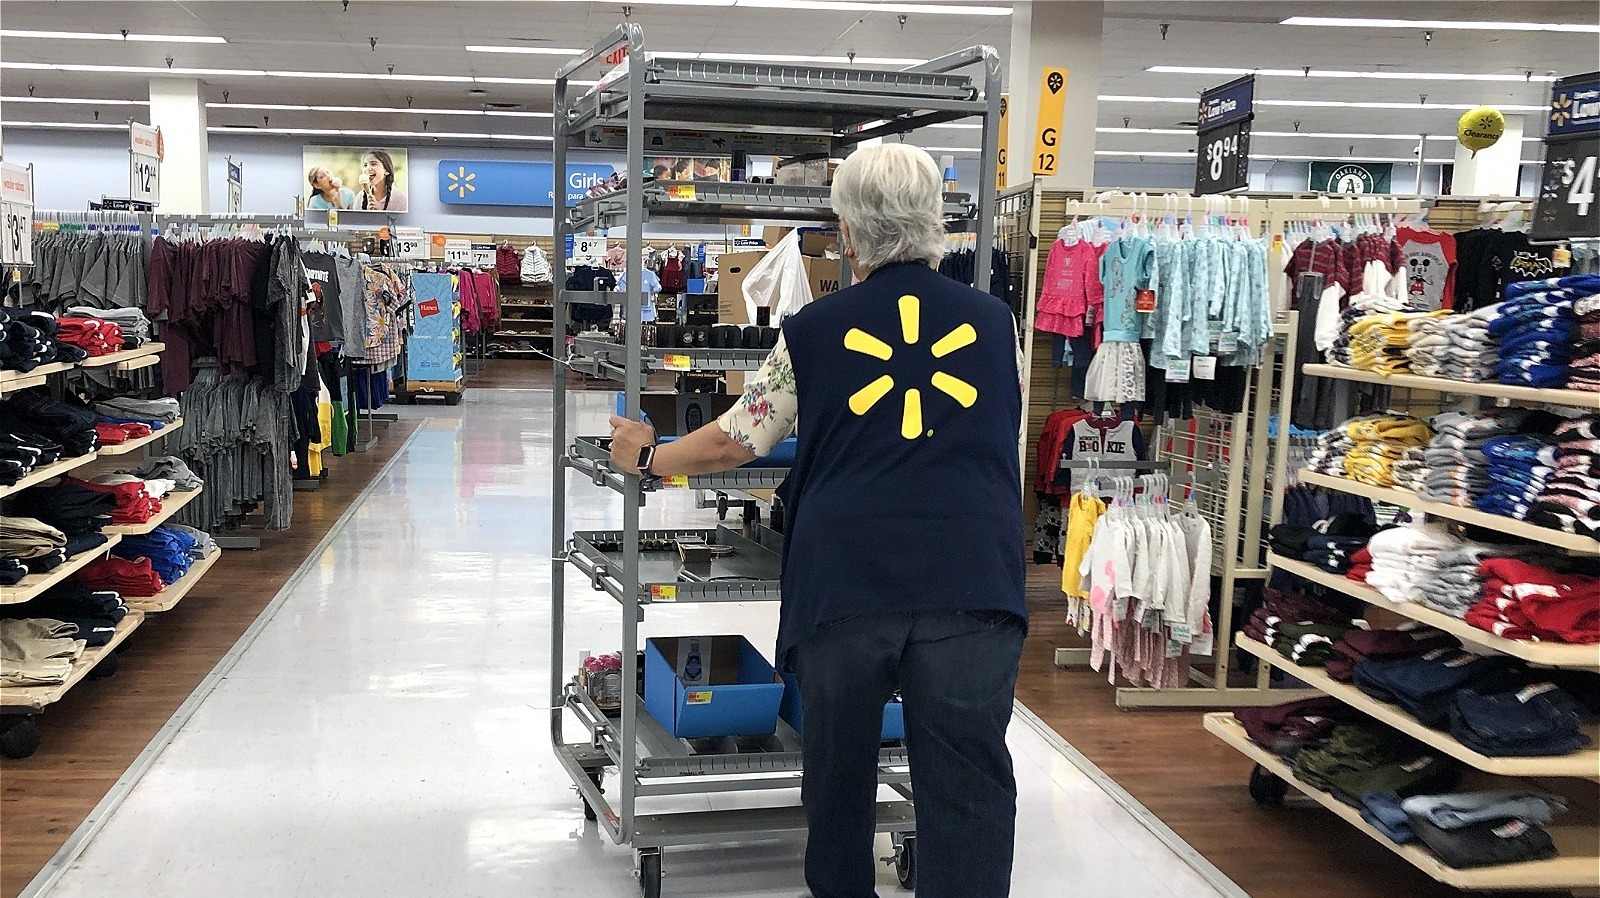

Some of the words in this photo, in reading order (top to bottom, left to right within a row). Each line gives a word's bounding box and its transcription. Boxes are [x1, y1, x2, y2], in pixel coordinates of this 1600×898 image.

[606, 45, 628, 64] EXIT
[1221, 99, 1236, 113] Price
[1042, 128, 1056, 146] G
[999, 148, 1005, 165] G
[1039, 153, 1055, 170] 12
[569, 172, 604, 189] Girls
[999, 172, 1004, 187] 11
[1335, 167, 1367, 180] OAKLAND
[1561, 156, 1600, 216] $4
